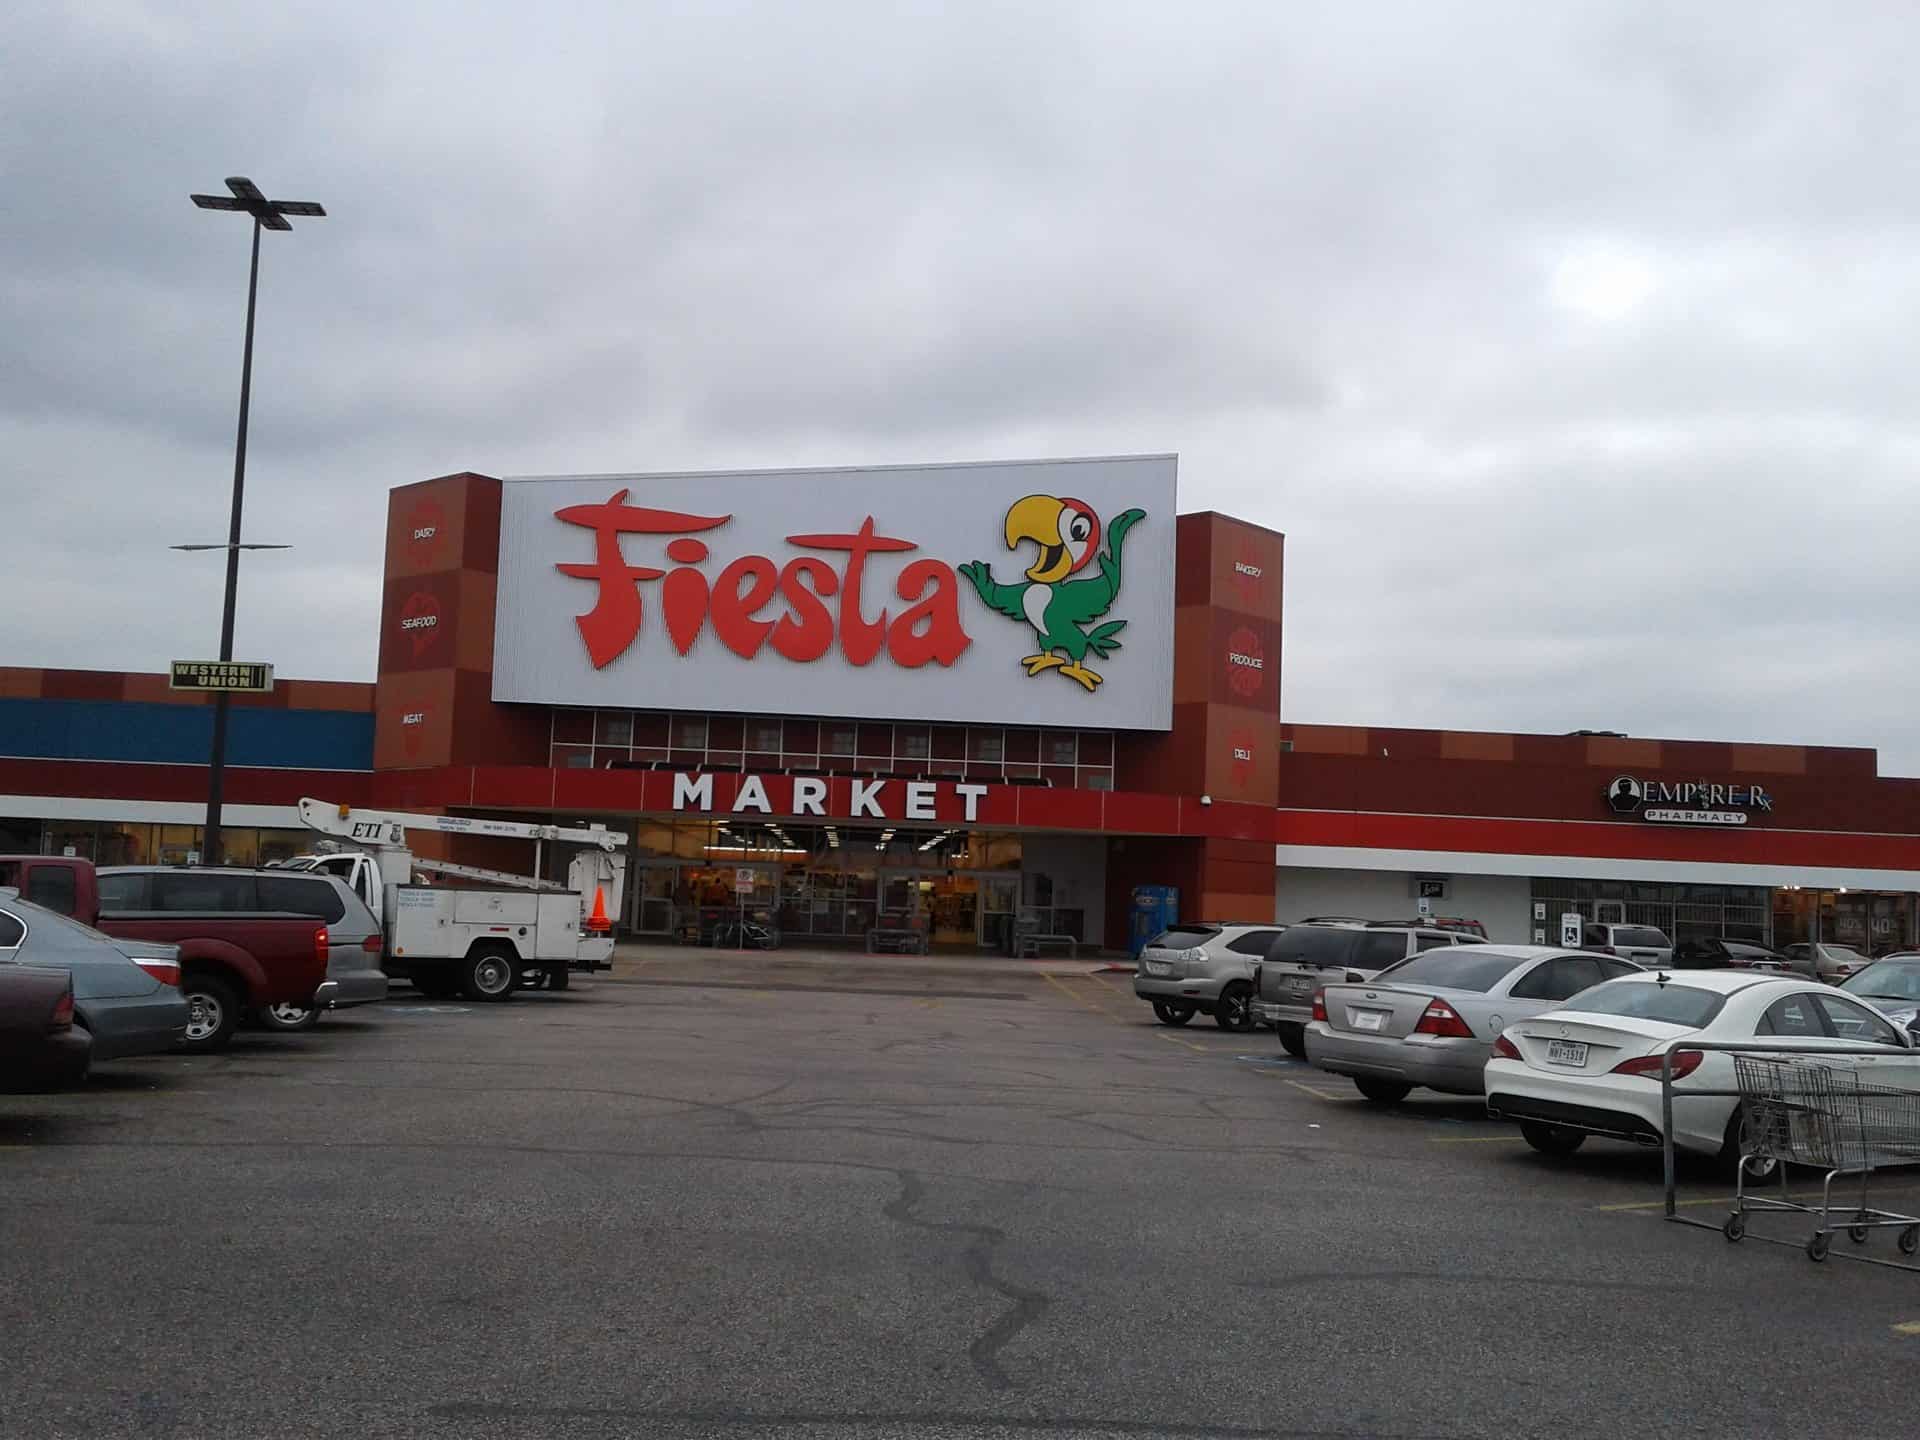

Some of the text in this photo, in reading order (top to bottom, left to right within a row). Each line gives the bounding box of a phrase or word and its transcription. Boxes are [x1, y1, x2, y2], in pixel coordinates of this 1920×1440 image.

[1235, 561, 1262, 578] BAKERY
[553, 487, 974, 670] Fiesta
[401, 615, 437, 629] SEAFOOD
[1229, 652, 1263, 669] PRODUCE
[175, 664, 250, 676] WESTERN
[198, 676, 250, 687] UNION
[671, 771, 988, 823] MARKET
[1647, 810, 1744, 823] PHARMACY
[352, 822, 382, 838] ETI
